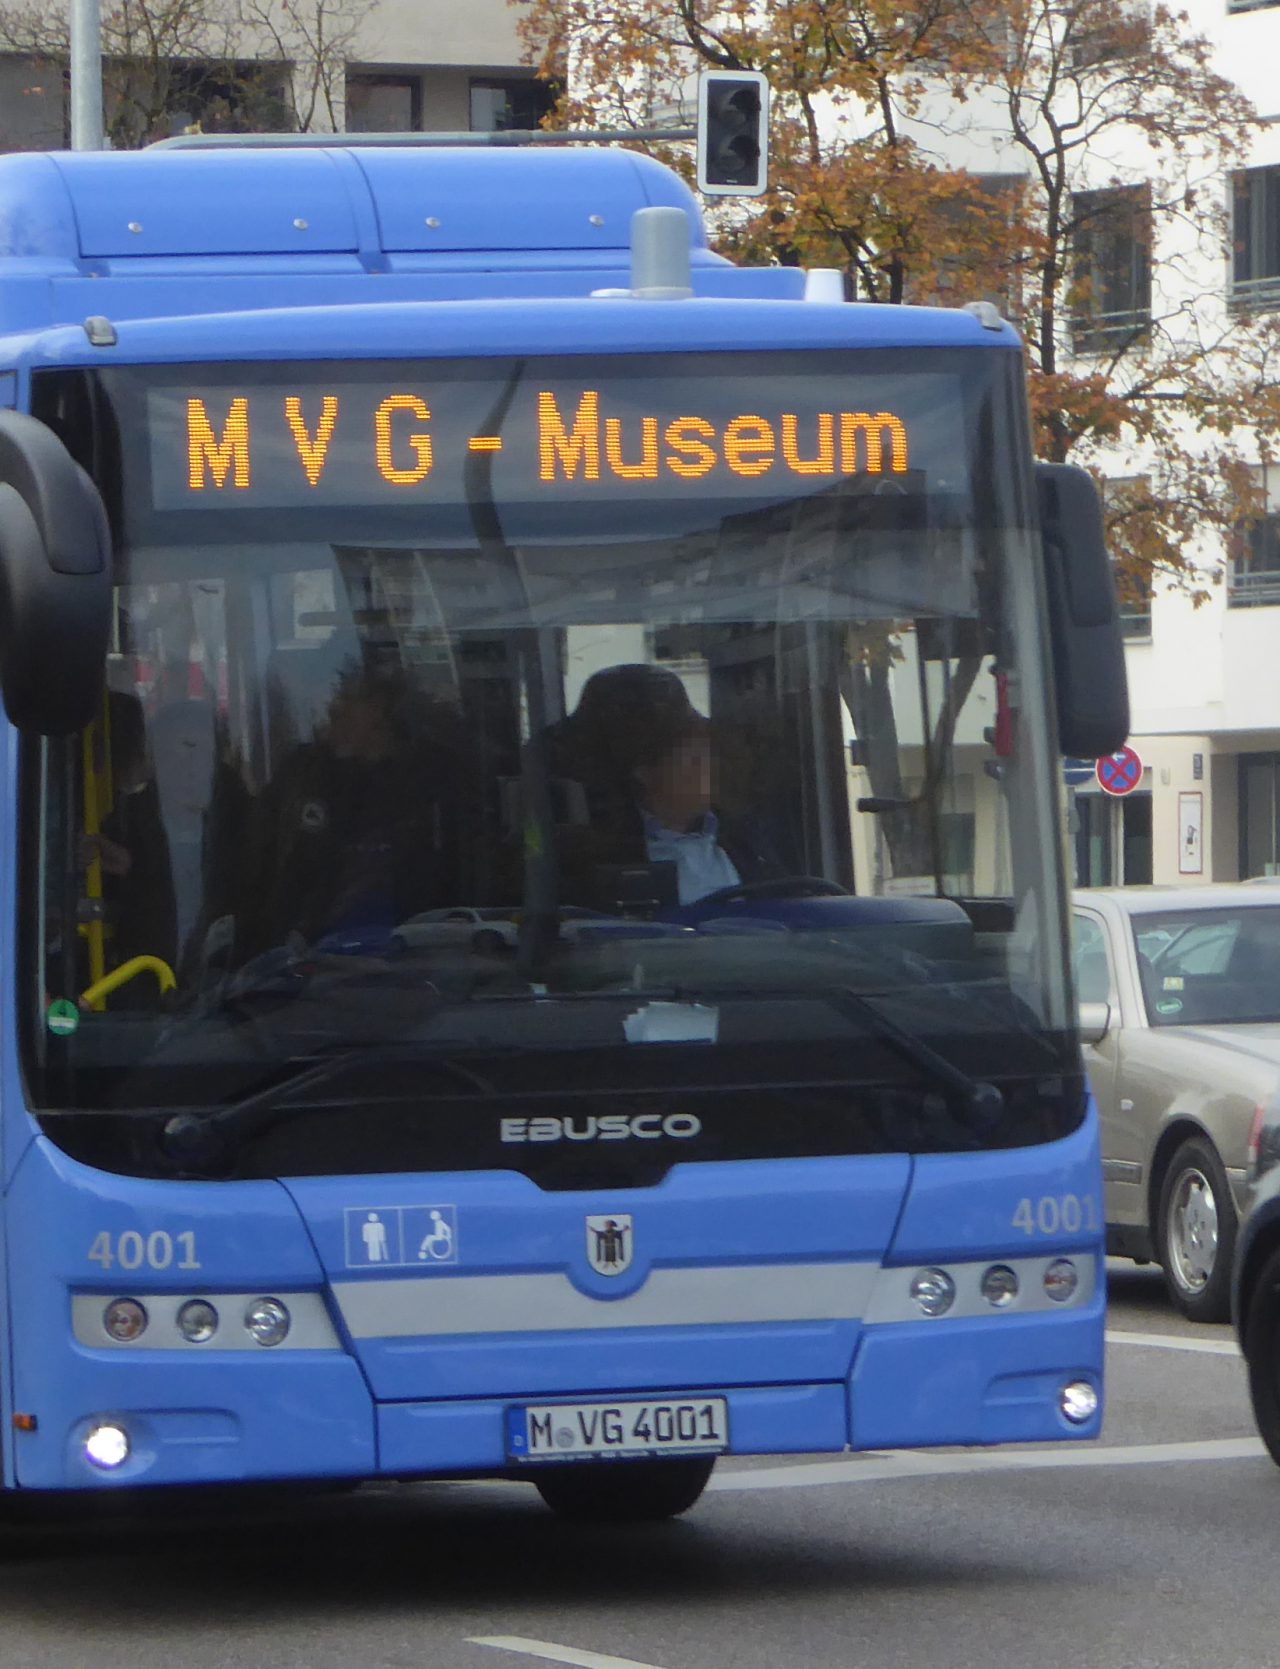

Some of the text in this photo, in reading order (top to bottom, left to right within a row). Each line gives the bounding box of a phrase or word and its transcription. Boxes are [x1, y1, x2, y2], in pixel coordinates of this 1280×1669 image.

[537, 390, 909, 481] Museum
[500, 1113, 702, 1143] EBUSCO
[1010, 1194, 1102, 1236] 4001
[87, 1230, 202, 1270] 4001
